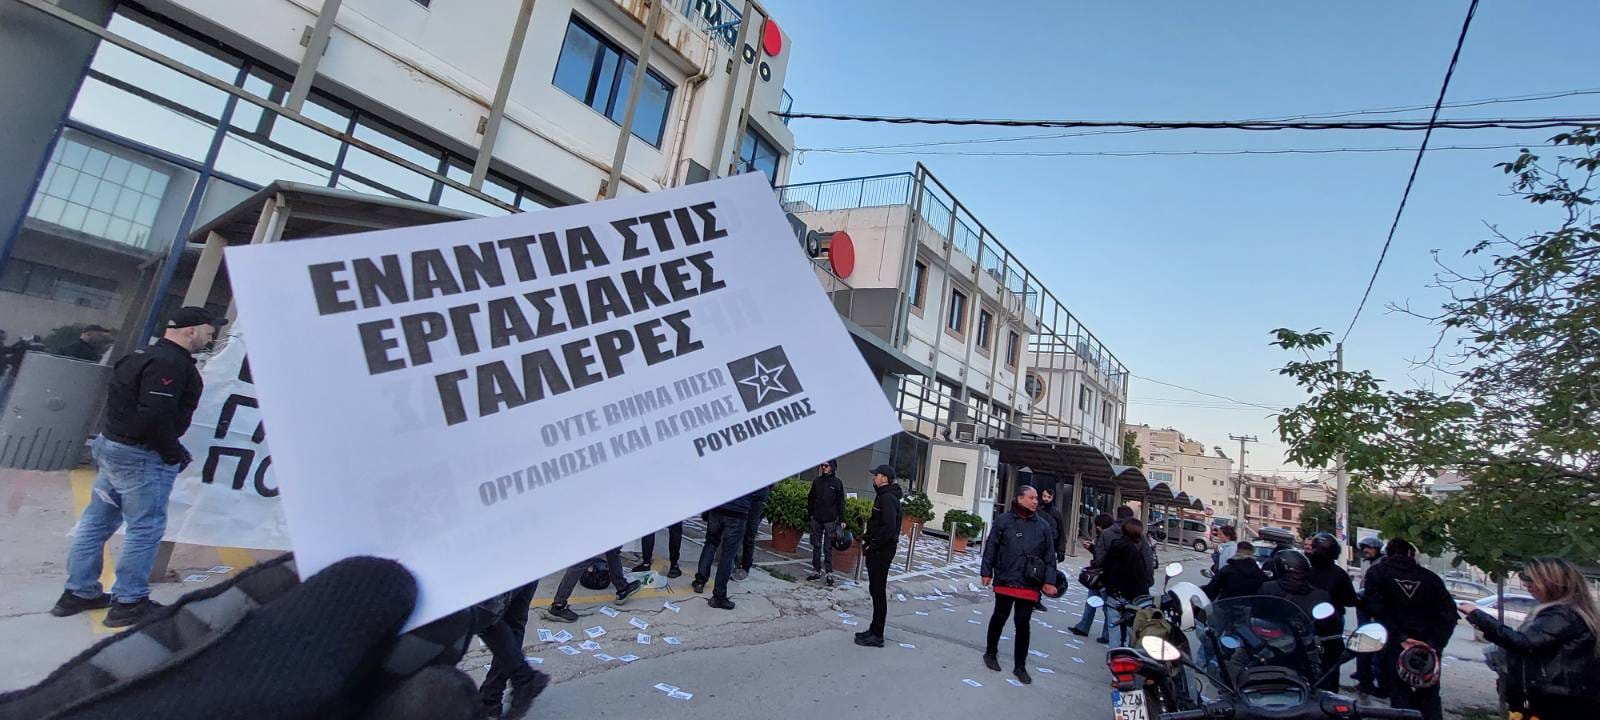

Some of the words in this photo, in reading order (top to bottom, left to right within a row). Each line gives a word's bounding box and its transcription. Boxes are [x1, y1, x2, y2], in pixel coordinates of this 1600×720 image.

[308, 225, 610, 316] ΕΝΑΝΤΙΑ
[610, 201, 729, 261] ΣΤΙΣ
[357, 250, 727, 375] ΕΡΓΑΣΙΑΚΕΣ
[434, 309, 704, 427] ΓΑΛΕΡΕΣ
[540, 408, 601, 448] ΟΥΤΕ
[602, 385, 674, 427] ΒΗΜΑ
[673, 367, 727, 400] ΠΙΣΩ
[478, 441, 608, 507] ΟΡΓΑΝΩΣΗ
[610, 425, 652, 459] ΚΑΙ
[654, 394, 739, 442] ΑΓΩΝΑΣ
[692, 397, 816, 458] ΡΟΥΒΙΚΩΝΑΣ
